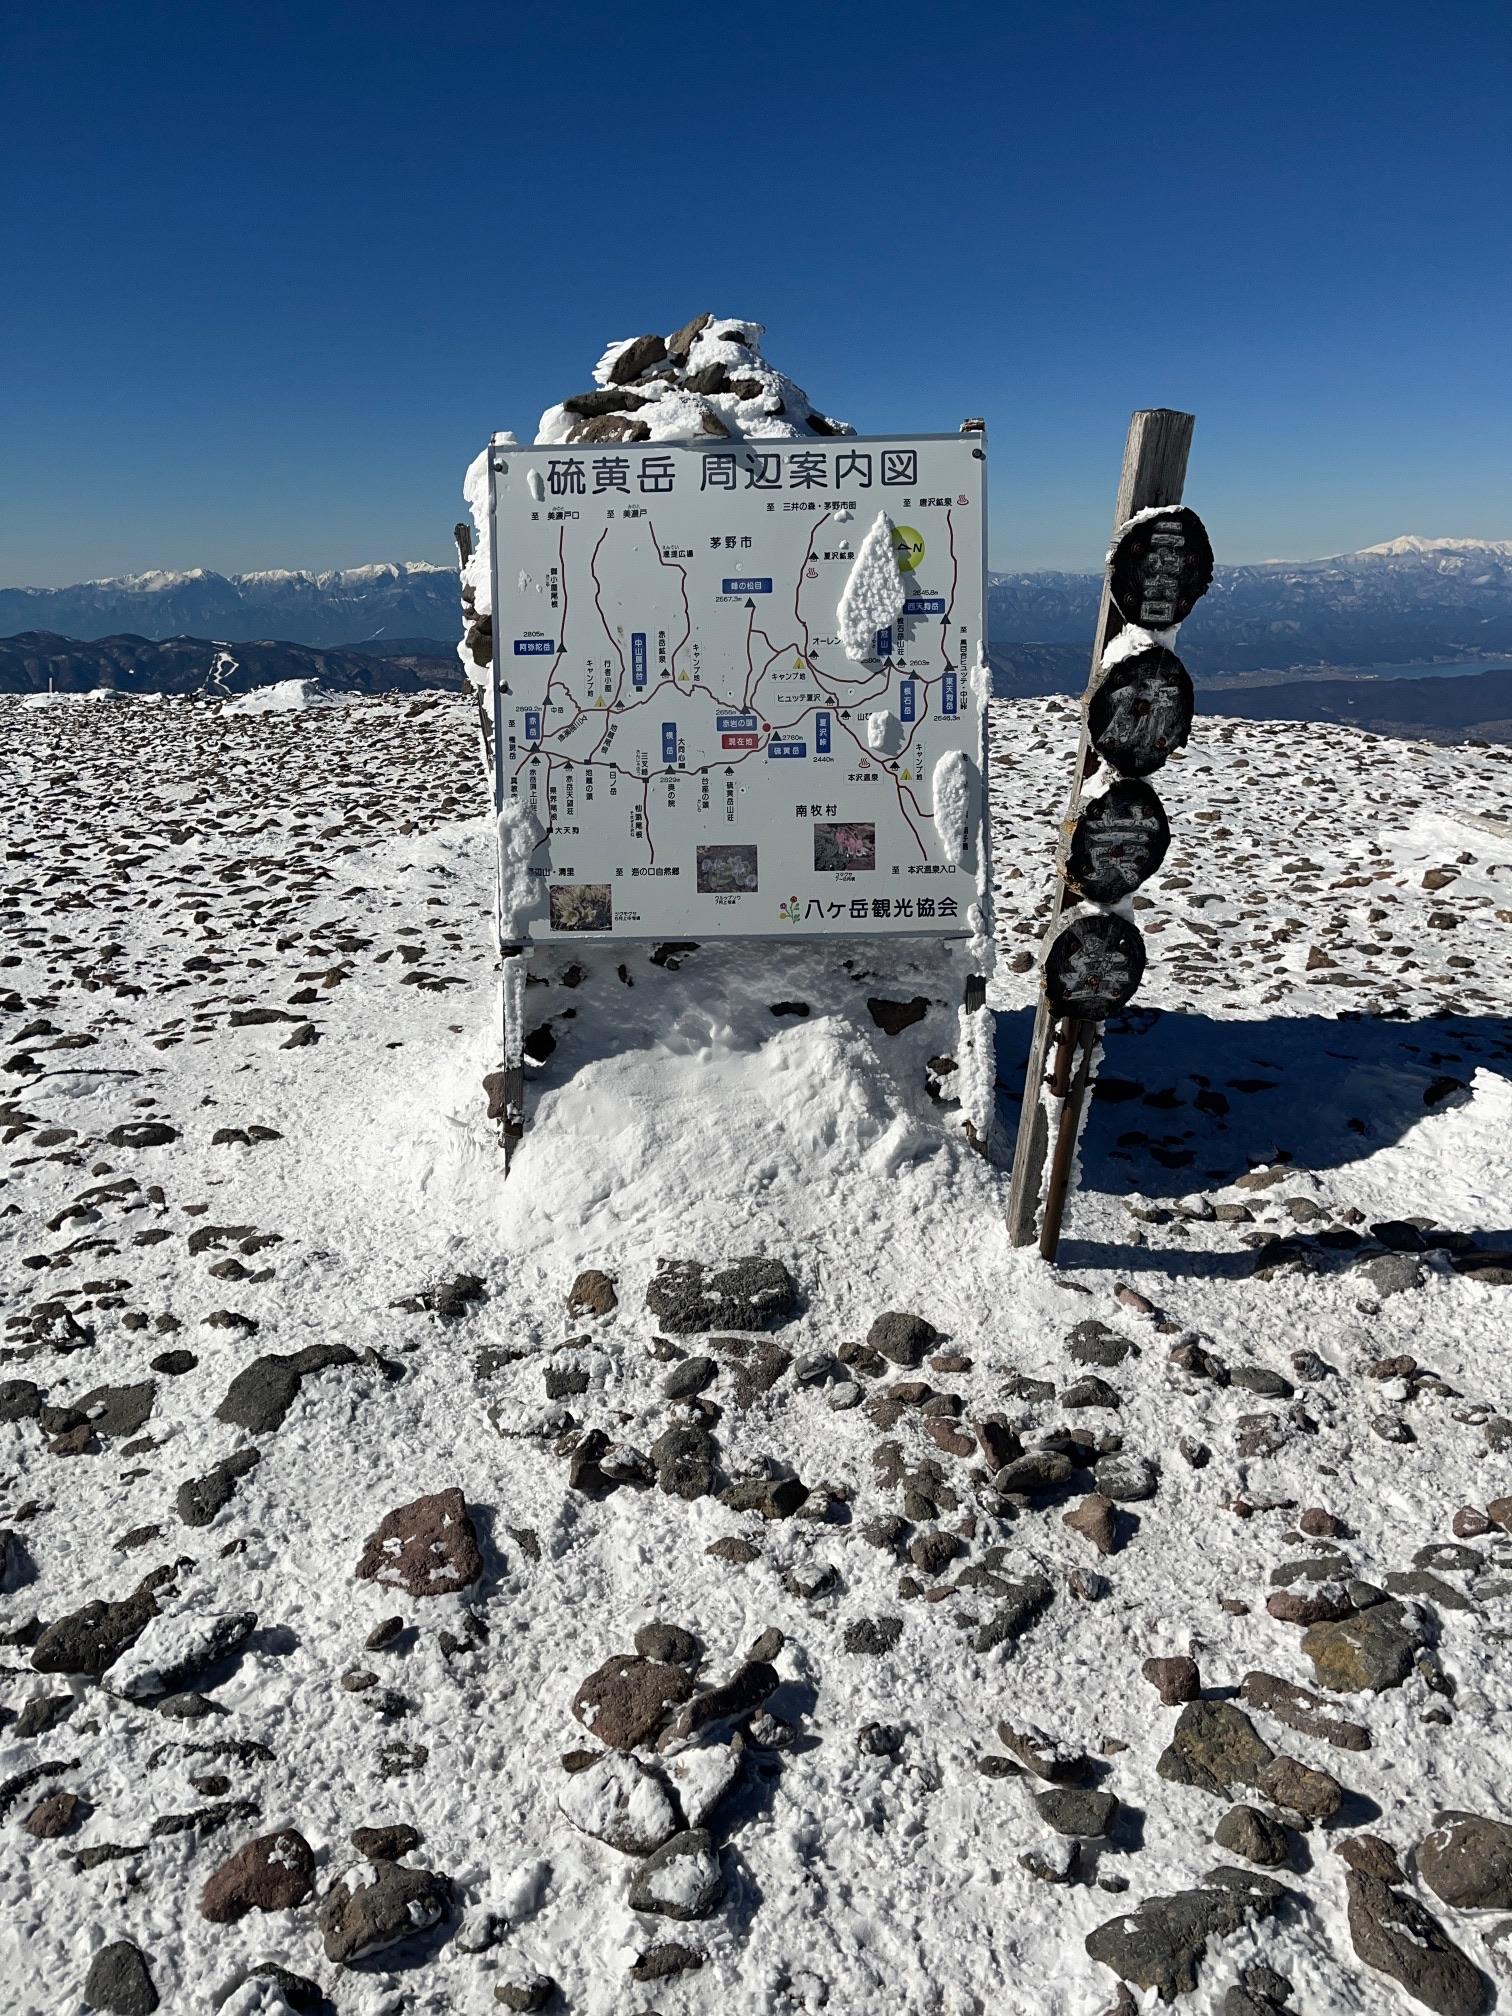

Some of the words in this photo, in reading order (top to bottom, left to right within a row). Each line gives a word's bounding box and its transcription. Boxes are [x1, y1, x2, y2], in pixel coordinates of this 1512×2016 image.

[547, 455, 675, 495] 硫黄岳
[700, 449, 917, 490] 周辺案内図
[710, 536, 752, 549] 茅野市
[913, 544, 923, 552] N
[520, 643, 551, 651] 阿弥陀岳
[728, 737, 753, 746] 現在地
[774, 747, 800, 755] 硫黄岳
[848, 773, 878, 782] 本沢温泉
[795, 805, 837, 817] 南牧村
[908, 865, 955, 874] 本沢温泉入口
